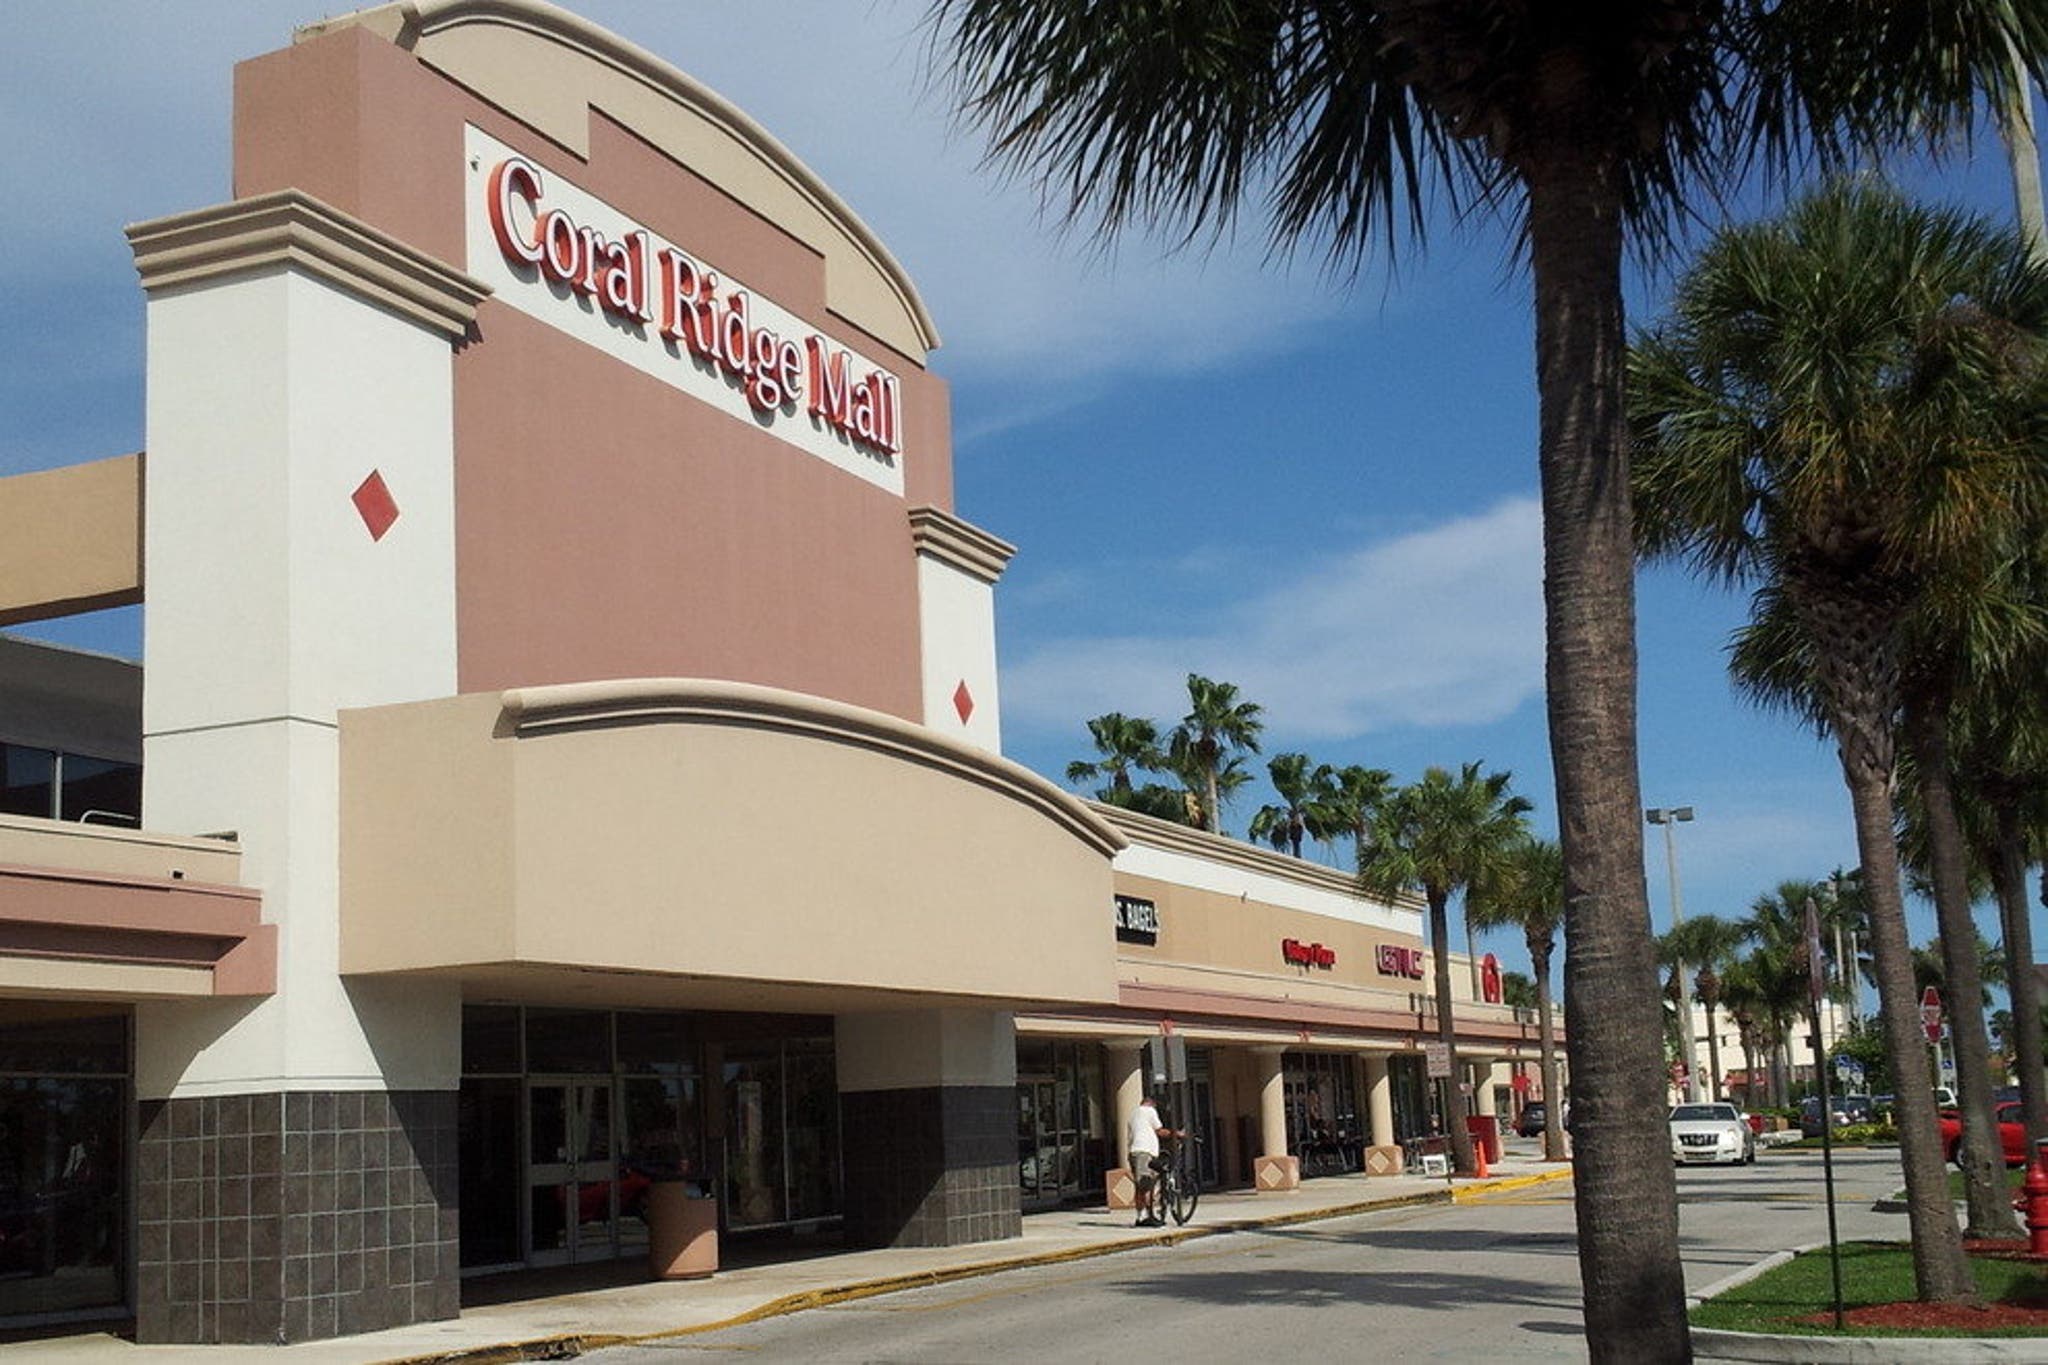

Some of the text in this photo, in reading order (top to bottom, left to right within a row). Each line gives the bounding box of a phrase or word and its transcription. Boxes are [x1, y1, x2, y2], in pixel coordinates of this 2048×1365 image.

[488, 156, 901, 457] Coral Ridge Mall
